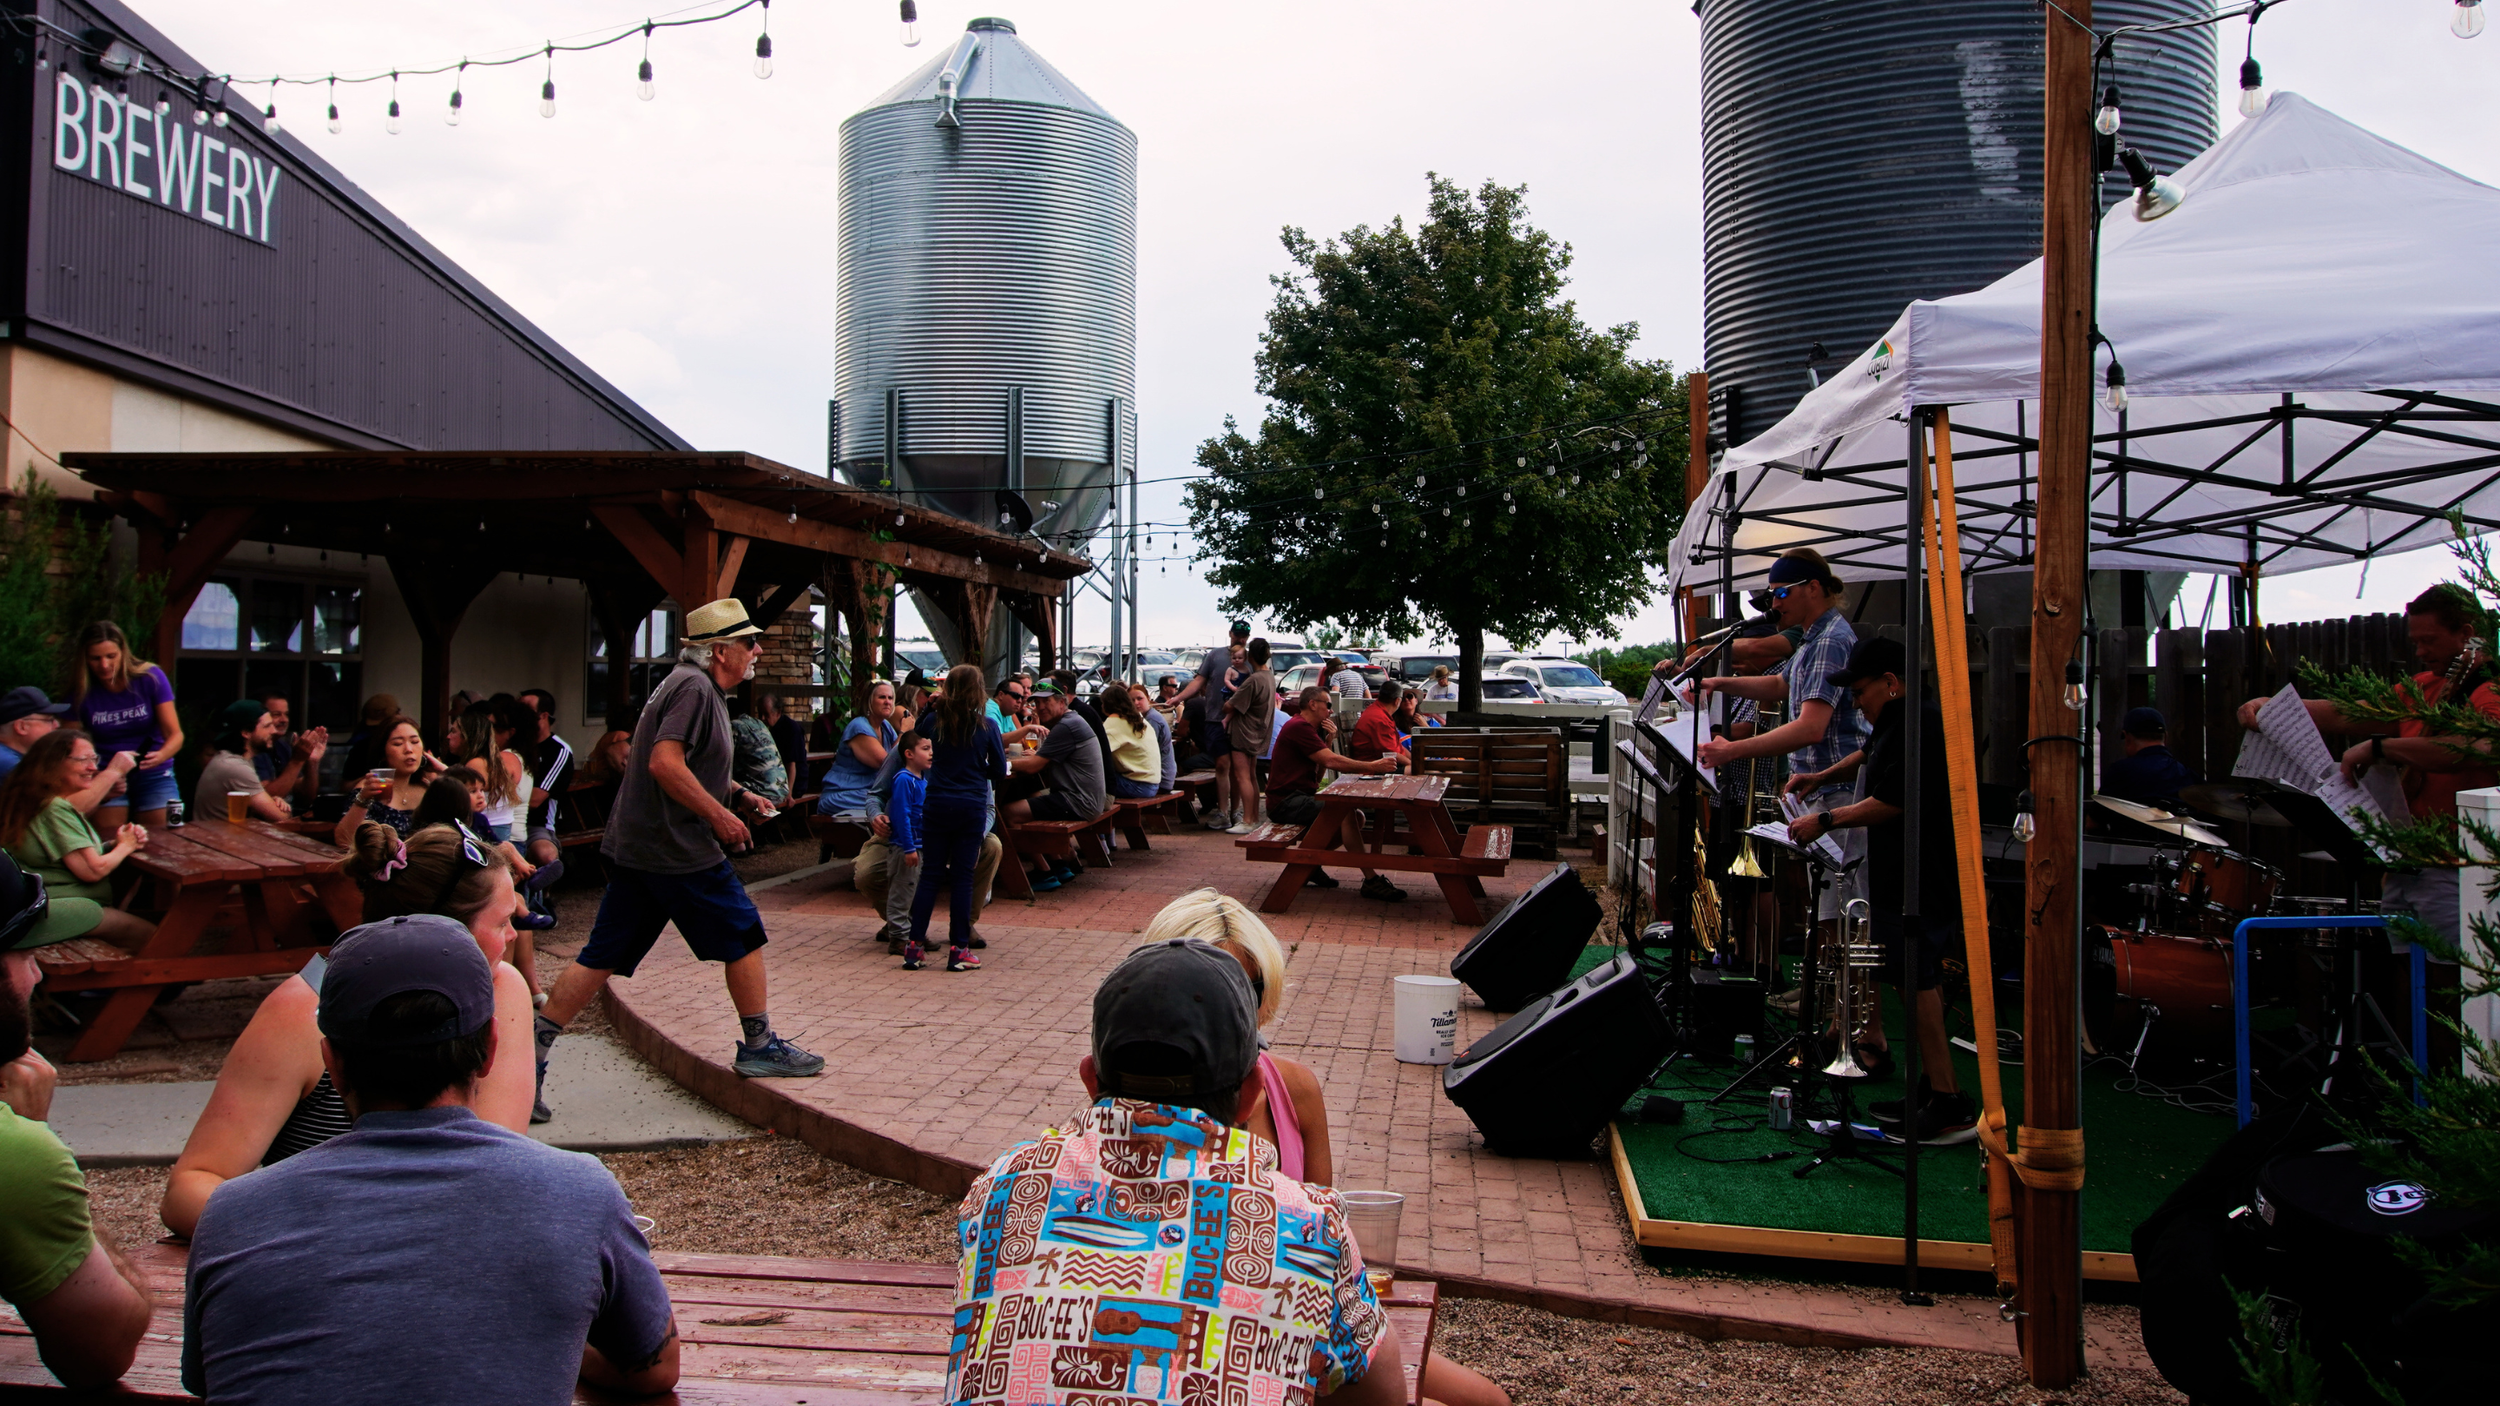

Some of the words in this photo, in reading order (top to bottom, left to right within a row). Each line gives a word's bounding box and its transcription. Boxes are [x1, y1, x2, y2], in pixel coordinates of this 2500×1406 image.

[55, 73, 281, 242] BREWERY
[92, 711, 120, 726] PIKES
[122, 705, 148, 719] PEAK
[974, 1176, 1010, 1298] BUC-EE'S
[1183, 1184, 1225, 1301] BUC-EE'S
[1017, 1294, 1093, 1343] BUC-EE'S
[1254, 1325, 1313, 1384] BUC-EE'S
